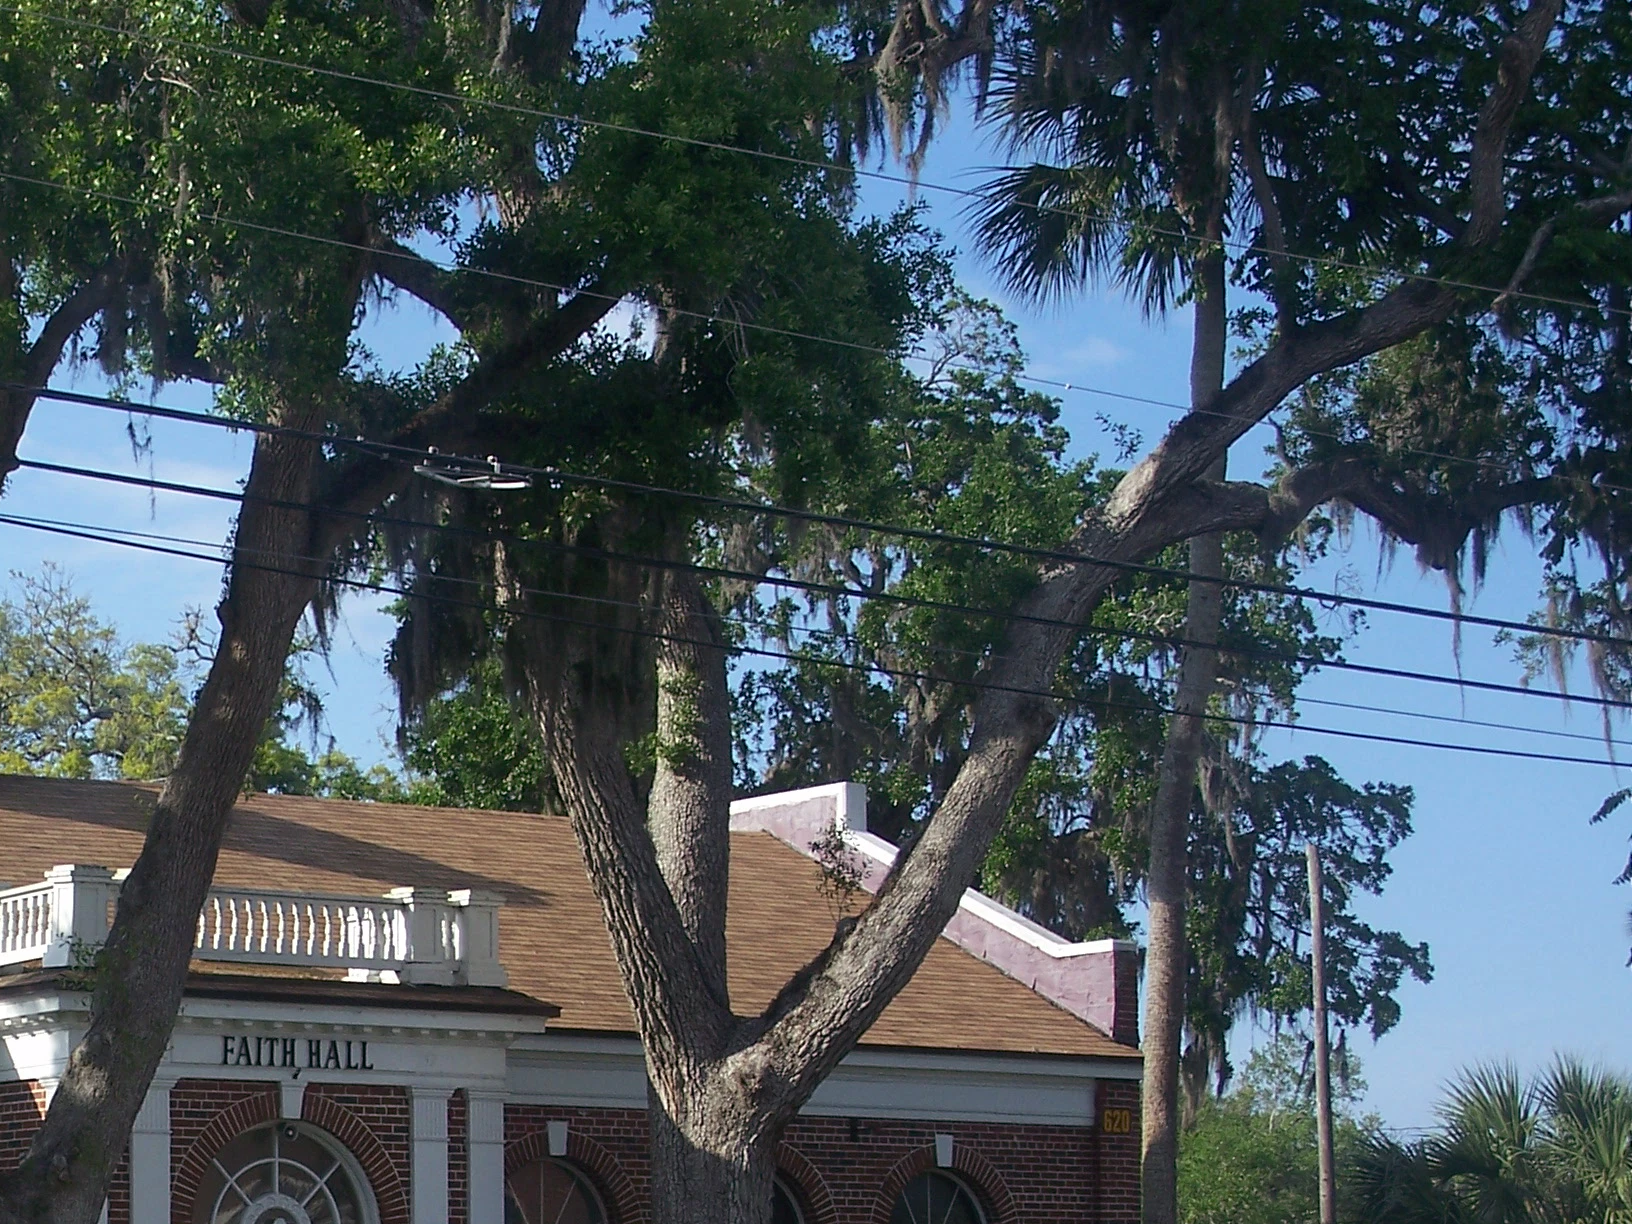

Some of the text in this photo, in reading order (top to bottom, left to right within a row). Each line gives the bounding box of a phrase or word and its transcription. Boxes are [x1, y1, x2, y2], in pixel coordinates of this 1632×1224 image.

[222, 1035, 374, 1070] FAITH HALL
[1104, 1109, 1130, 1133] 620
